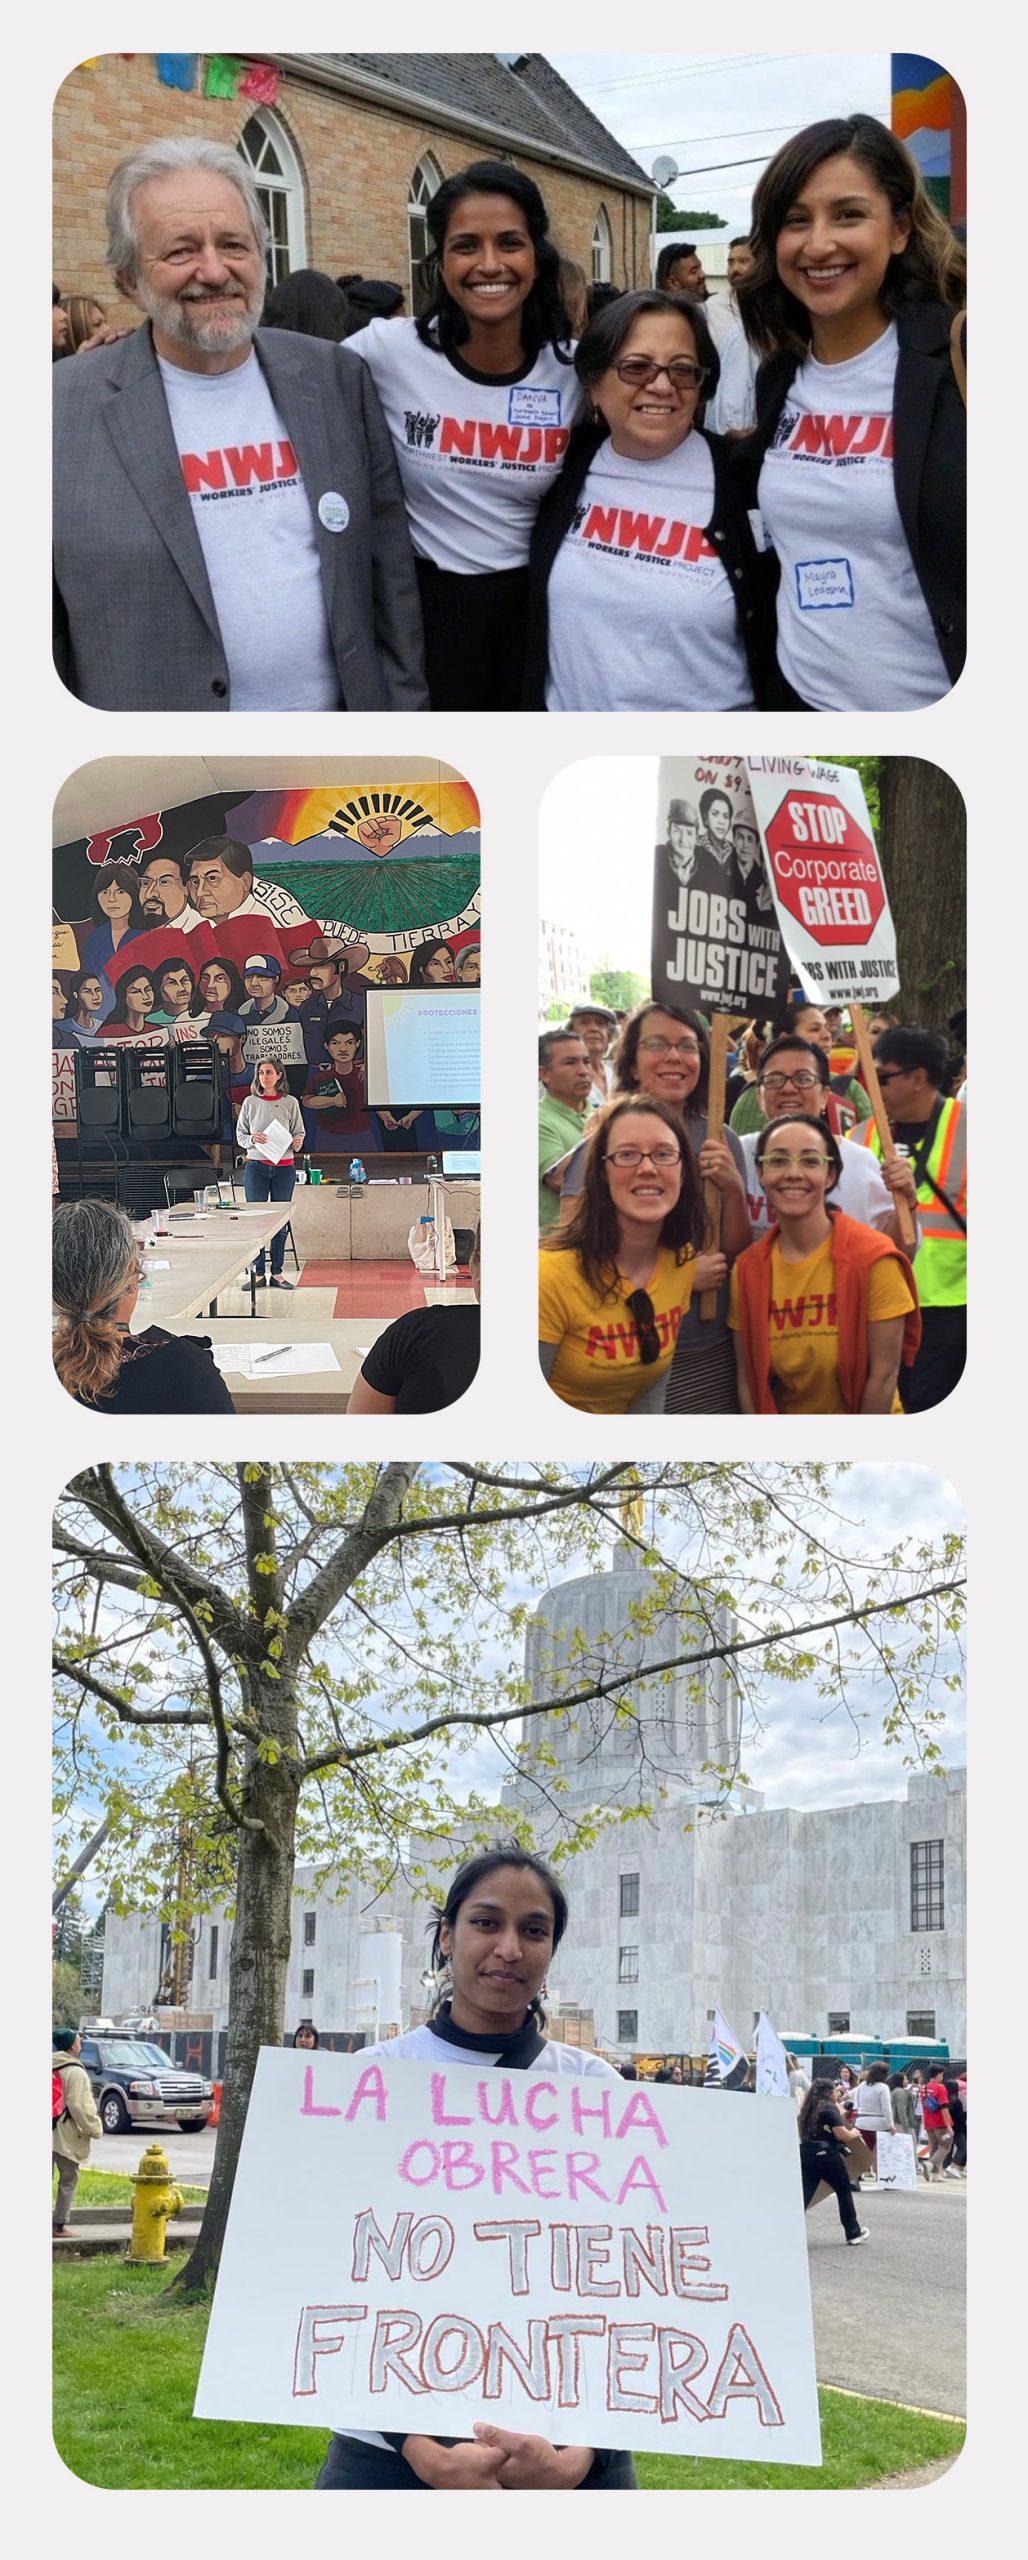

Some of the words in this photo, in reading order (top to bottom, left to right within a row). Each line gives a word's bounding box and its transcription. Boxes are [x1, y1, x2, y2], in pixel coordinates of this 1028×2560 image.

[439, 417, 570, 464] NWJP
[501, 461, 532, 472] JUSTICE
[259, 479, 298, 493] JUSTICE
[582, 504, 720, 562] NWJP
[634, 553, 672, 567] JUSTICE
[673, 560, 717, 577] PROJECT
[695, 767, 718, 785] ON
[748, 756, 805, 775] LIVING
[788, 801, 848, 845] STOP
[774, 850, 878, 886] Corporate
[269, 891, 304, 926] SE
[323, 920, 369, 945] PUEDE
[385, 916, 471, 952] TIERRA
[668, 886, 747, 944] JOBS
[748, 924, 780, 952] WITH
[798, 886, 873, 926] GREED
[666, 937, 779, 998] JUSTICE
[824, 960, 857, 980] WITH
[859, 959, 896, 979] JUSTICE
[828, 985, 879, 1000] www.jwj.org
[418, 1008, 478, 1017] PROTECCIONES
[175, 1024, 198, 1042] INS
[248, 1028, 259, 1037] NO
[262, 1026, 292, 1037] SOMOS
[260, 1044, 288, 1053] SOMOS
[300, 2064, 388, 2121] LA
[431, 2072, 669, 2148] LUCHA
[397, 2138, 669, 2213] OBRERA
[351, 2208, 456, 2284] NO
[473, 2219, 729, 2301] TIENE
[292, 2304, 786, 2427] FRONTERA
